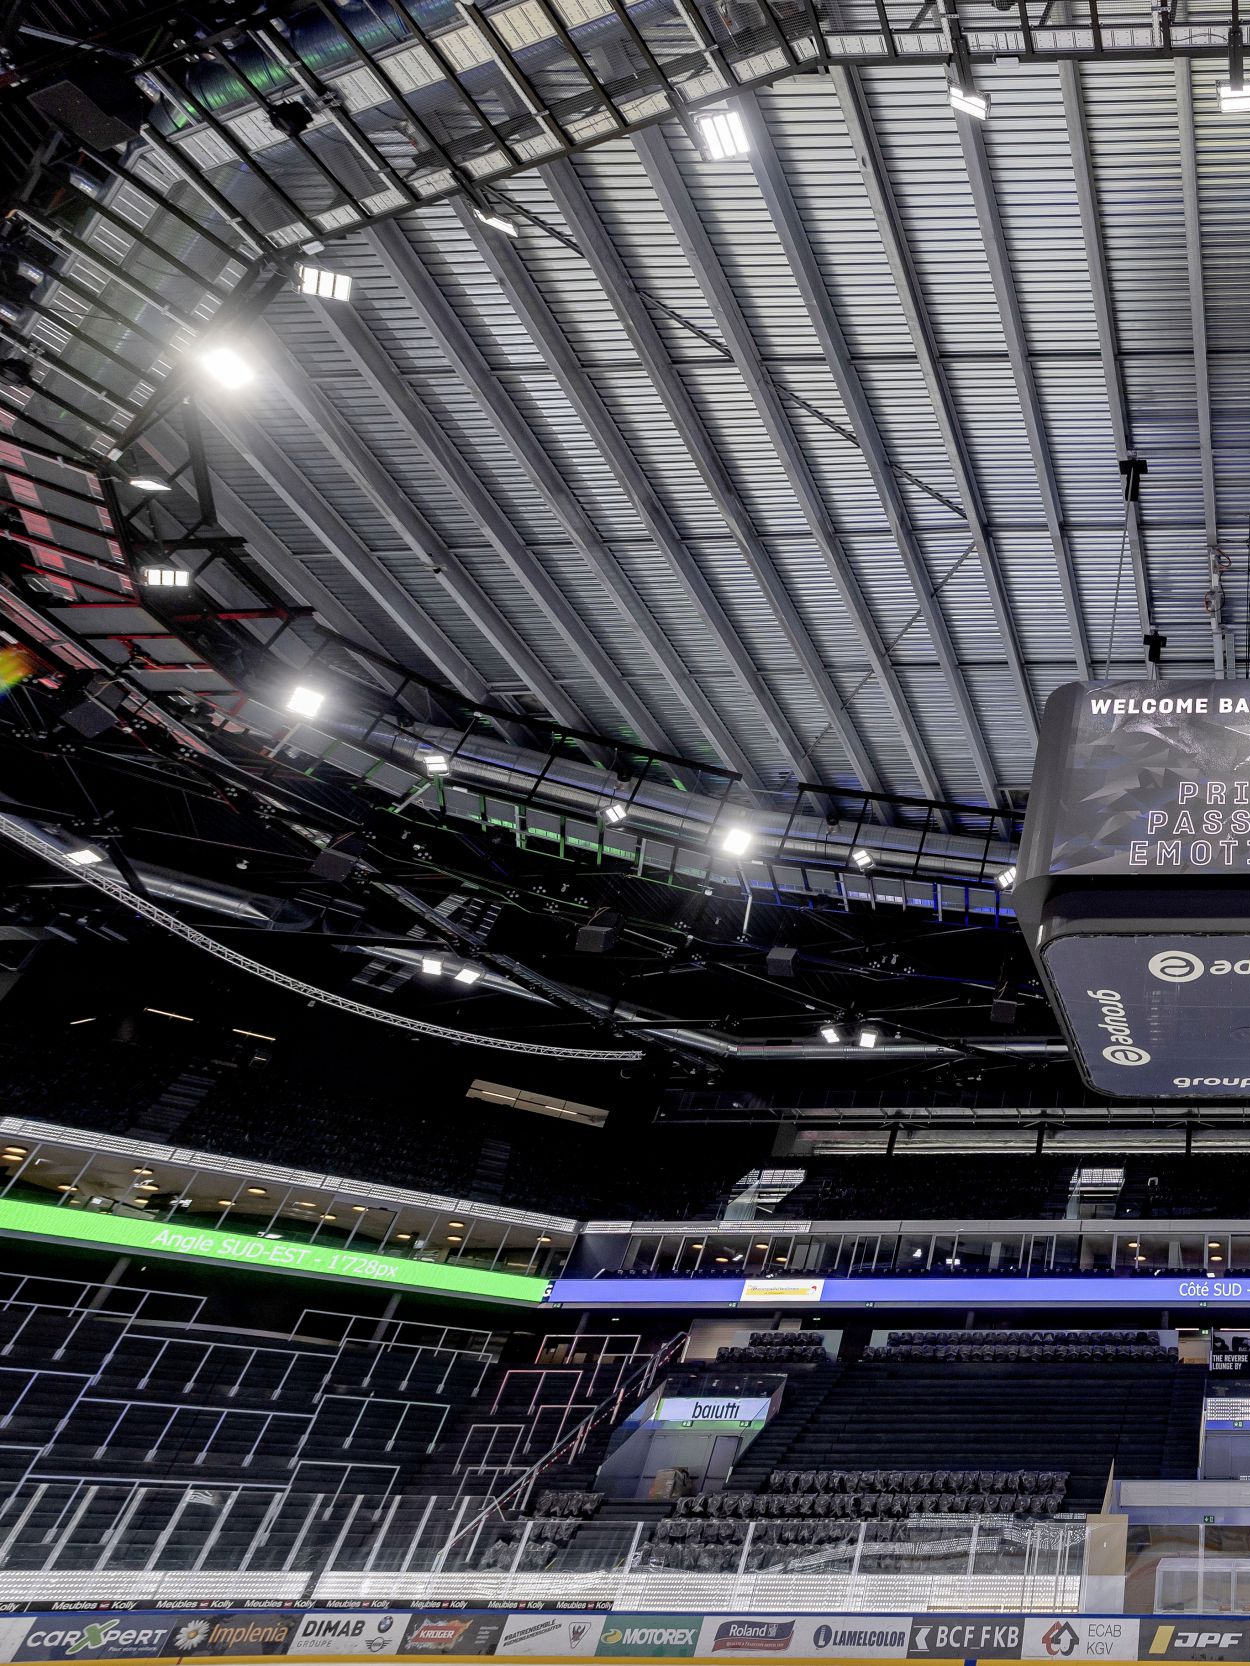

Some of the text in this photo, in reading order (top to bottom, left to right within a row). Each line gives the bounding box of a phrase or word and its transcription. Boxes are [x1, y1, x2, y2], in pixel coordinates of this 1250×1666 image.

[1091, 698, 1208, 715] WELCOME
[1087, 989, 1133, 1045] groupe
[150, 1229, 213, 1253] Angle
[218, 1238, 311, 1265] SUD-EST
[328, 1254, 400, 1278] 1'728px
[1179, 1281, 1209, 1297] Côté
[1213, 1282, 1242, 1297] SUD
[1212, 1354, 1248, 1363] THE REVERSE
[52, 1601, 138, 1611] Meubles Kolly
[156, 1600, 234, 1610] Meubles Kolly
[244, 1600, 283, 1608] Meubles
[326, 1600, 363, 1608] Meubles
[410, 1600, 440, 1609] Meubles
[488, 1601, 519, 1609] Meubles
[208, 1621, 289, 1648] Implenia
[302, 1620, 366, 1638] DIMAB
[729, 1624, 766, 1637] Roland
[1088, 1624, 1122, 1637] ECAB
[622, 1628, 695, 1645] MOTOREX
[833, 1631, 905, 1648] LAMELCOLOR
[1174, 1632, 1243, 1648] JPF
[297, 1640, 332, 1648] GROUPE
[1087, 1642, 1114, 1655] KGV
